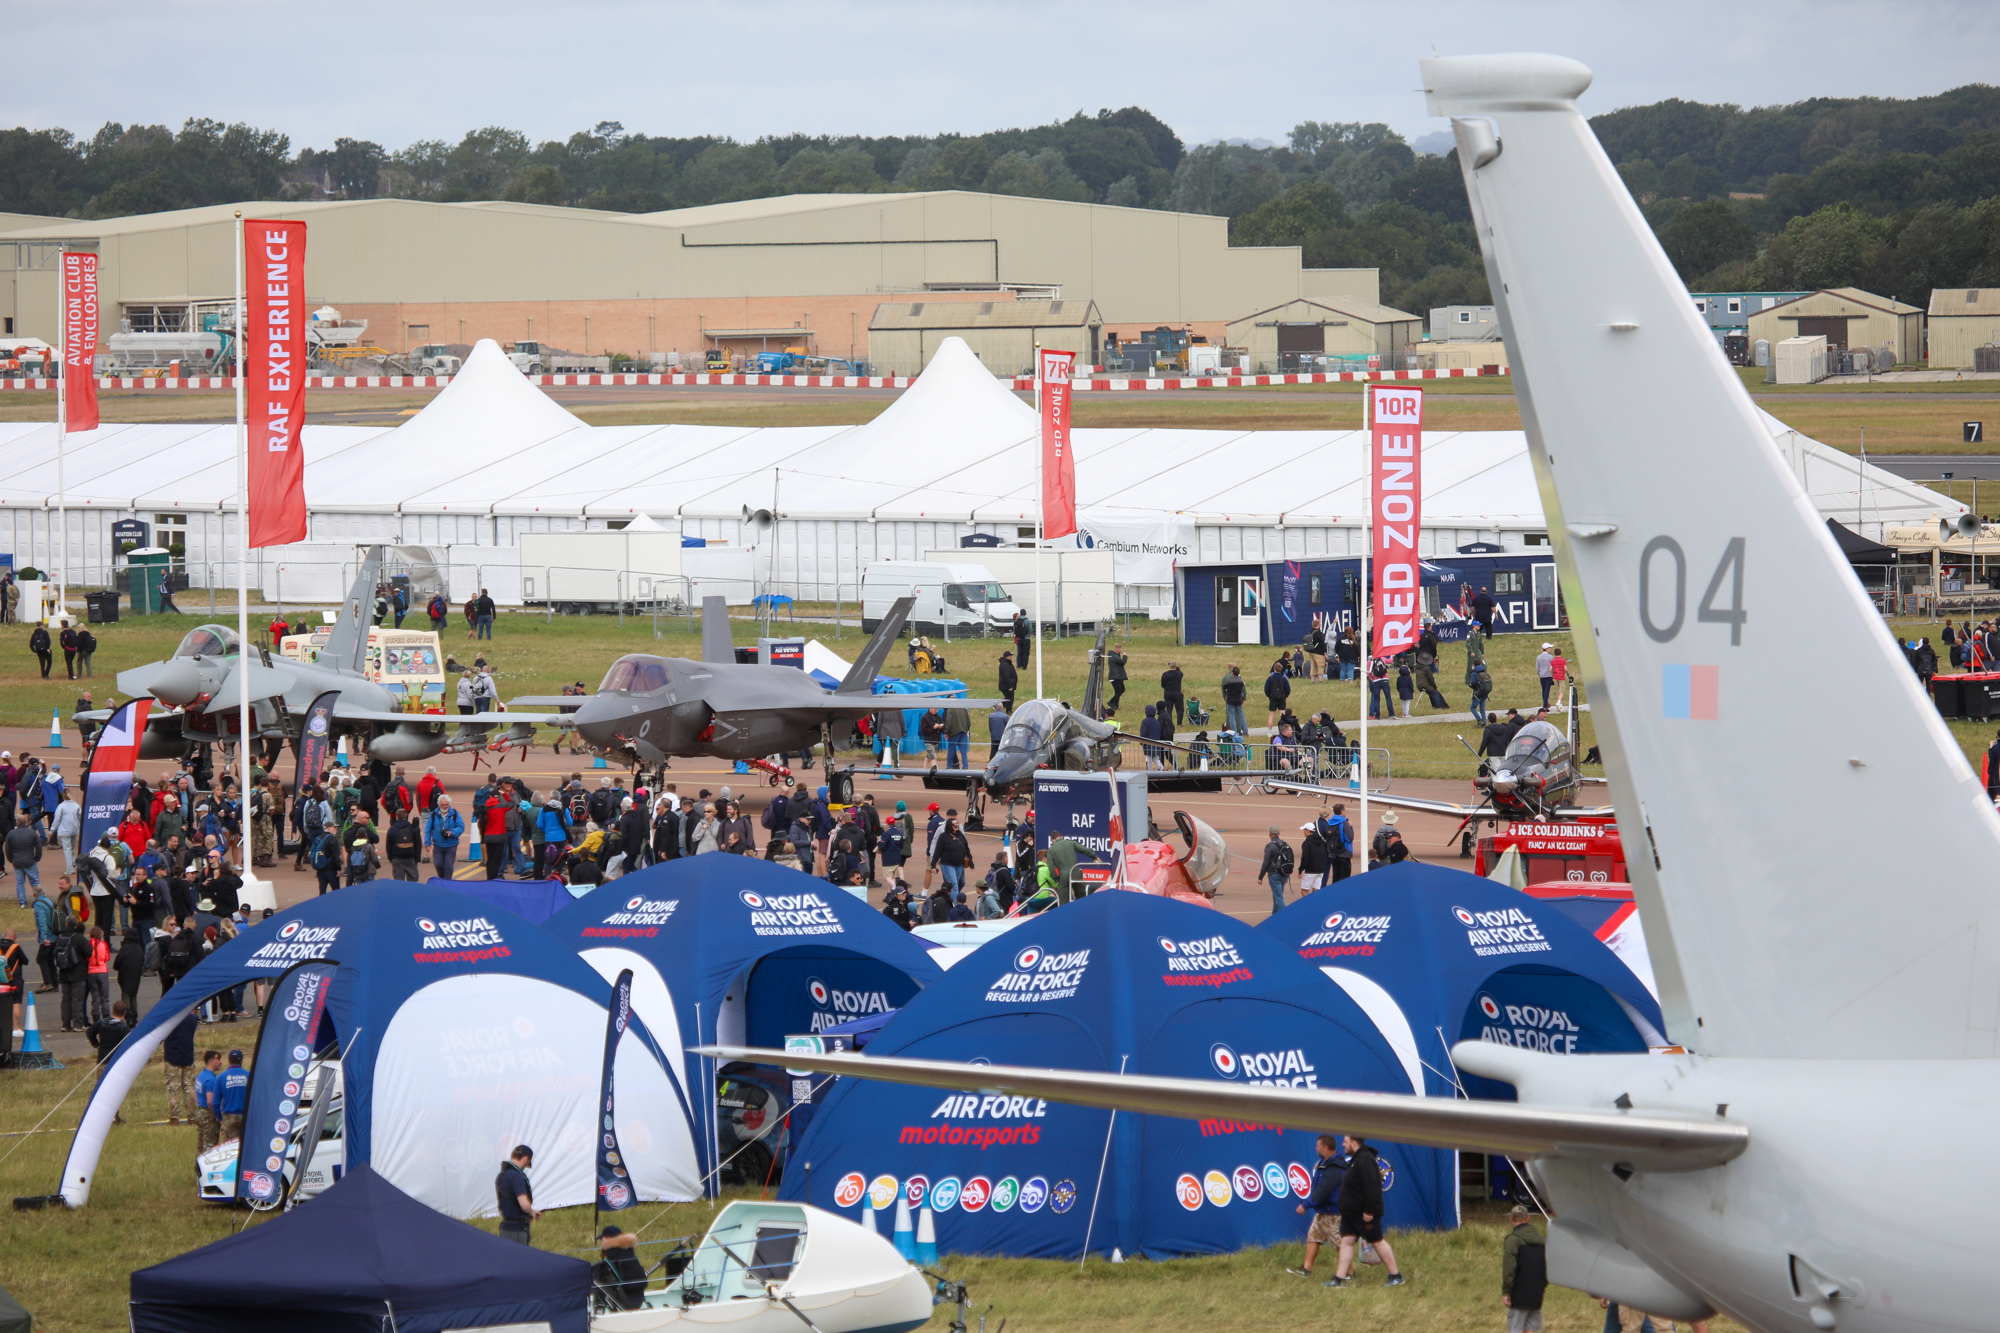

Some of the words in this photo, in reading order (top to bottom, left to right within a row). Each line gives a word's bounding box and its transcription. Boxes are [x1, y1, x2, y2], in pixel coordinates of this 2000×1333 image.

[66, 256, 80, 292] CLUB
[84, 256, 97, 350] ENCLOSURES
[266, 230, 290, 391] EXPERIENCE
[68, 298, 82, 366] AVIATION
[1048, 360, 1068, 378] 7R
[1052, 388, 1062, 425] ZONE
[1379, 398, 1416, 416] 10R
[268, 402, 288, 452] RAF
[1968, 423, 1979, 442] 7
[1054, 430, 1062, 457] RED
[1382, 434, 1414, 549] ZONE
[1097, 540, 1140, 553] Cambium
[1142, 543, 1188, 555] Networks
[1640, 534, 1748, 646] 04
[1382, 563, 1414, 648] RED
[300, 739, 315, 789] quadron
[1072, 814, 1096, 828] RAF
[1518, 824, 1533, 836] ICE
[1534, 825, 1559, 837] COLD
[1560, 826, 1596, 837] DRINKS
[1528, 841, 1546, 850] FANCY
[638, 900, 679, 912] ROYAL
[765, 894, 828, 910] ROYAL
[438, 917, 494, 934] ROYAL
[602, 913, 632, 924] AIR
[628, 912, 672, 924] FORCE
[751, 912, 781, 926] AIR
[776, 908, 838, 926] FORCE
[1341, 916, 1392, 929] ROYAL
[1475, 908, 1532, 927] ROYAL
[293, 927, 340, 942] ROYAL
[423, 936, 451, 949] AIR
[447, 930, 503, 948] FORCE
[581, 926, 660, 940] motorsports
[754, 927, 795, 936] REGULAR
[802, 924, 844, 935] RESERVE
[1301, 932, 1334, 946] AIR
[1332, 930, 1387, 943] FORCE
[1468, 930, 1496, 946] AIR
[1488, 924, 1545, 944] FORCE
[252, 943, 287, 958] AIR
[282, 944, 332, 959] FORCE
[413, 946, 511, 963] motorsports
[1178, 936, 1234, 956] ROYAL
[1298, 944, 1376, 959] torsports
[1474, 945, 1510, 957] REGULAR
[1508, 945, 1517, 953] &
[1515, 942, 1552, 953] RESERVE
[1038, 949, 1090, 972] ROYAL
[1168, 958, 1194, 971] AIR
[1188, 950, 1244, 971] FORCE
[990, 974, 1031, 991] AIR
[1029, 968, 1086, 991] FORCE
[1162, 968, 1253, 988] motorsports
[293, 972, 310, 1007] ROYAL
[303, 974, 320, 1010] FORCE
[985, 991, 1033, 1002] REGULAR
[1032, 993, 1040, 1002] &
[1040, 988, 1077, 1001] RESERVE
[306, 977, 331, 1044] motorsports
[831, 990, 896, 1013] ROYAL
[298, 1010, 311, 1030] AIR
[810, 1012, 836, 1032] AIR
[1505, 1005, 1580, 1032] ROYAL
[1481, 1026, 1515, 1048] AIR
[1514, 1029, 1578, 1056] FORCE
[1240, 1050, 1314, 1078] ROYAL
[719, 1080, 730, 1096] 4
[720, 1098, 744, 1108] Ockendon
[931, 1095, 979, 1119] AIR
[978, 1095, 1047, 1119] FORCE
[899, 1123, 1041, 1150] motorsports
